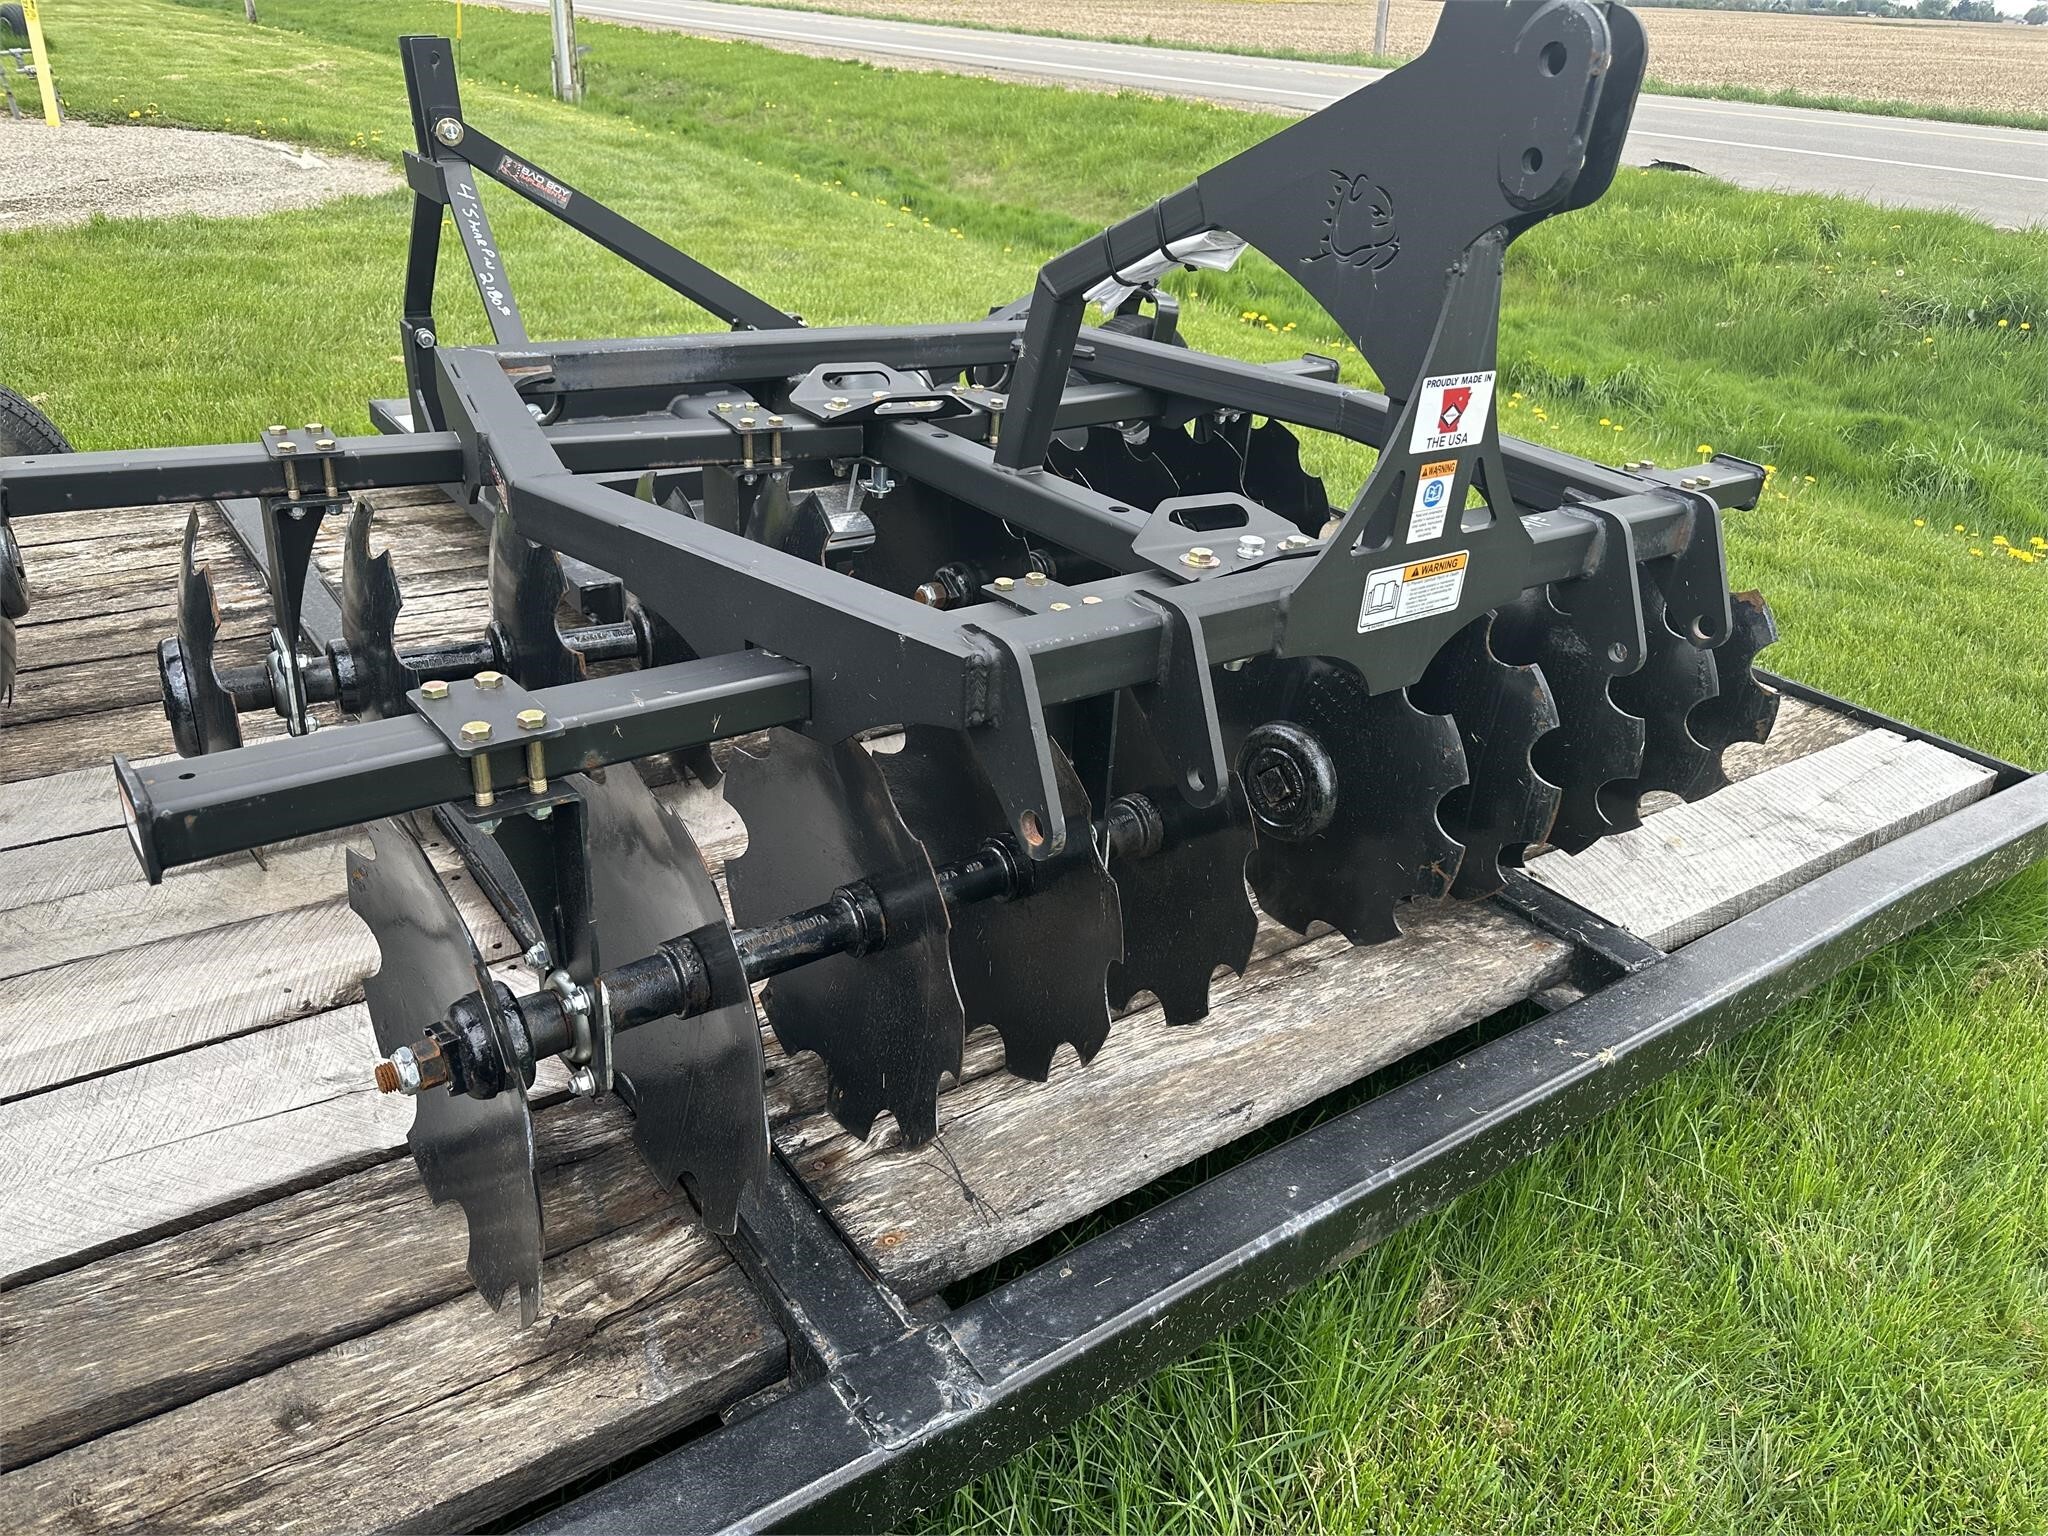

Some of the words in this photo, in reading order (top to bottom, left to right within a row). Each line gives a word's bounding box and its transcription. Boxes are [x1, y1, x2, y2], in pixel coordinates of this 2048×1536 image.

[519, 174, 567, 202] IMPLEMENTS
[521, 166, 545, 184] BAD
[546, 180, 570, 196] BOY
[1426, 377, 1459, 389] PROUDLY
[1461, 374, 1482, 385] MADE
[1484, 373, 1493, 383] IN
[1426, 435, 1446, 449] THE
[1448, 432, 1468, 446] USA
[1428, 462, 1456, 477] WARNING
[1421, 558, 1459, 576] WARNING
